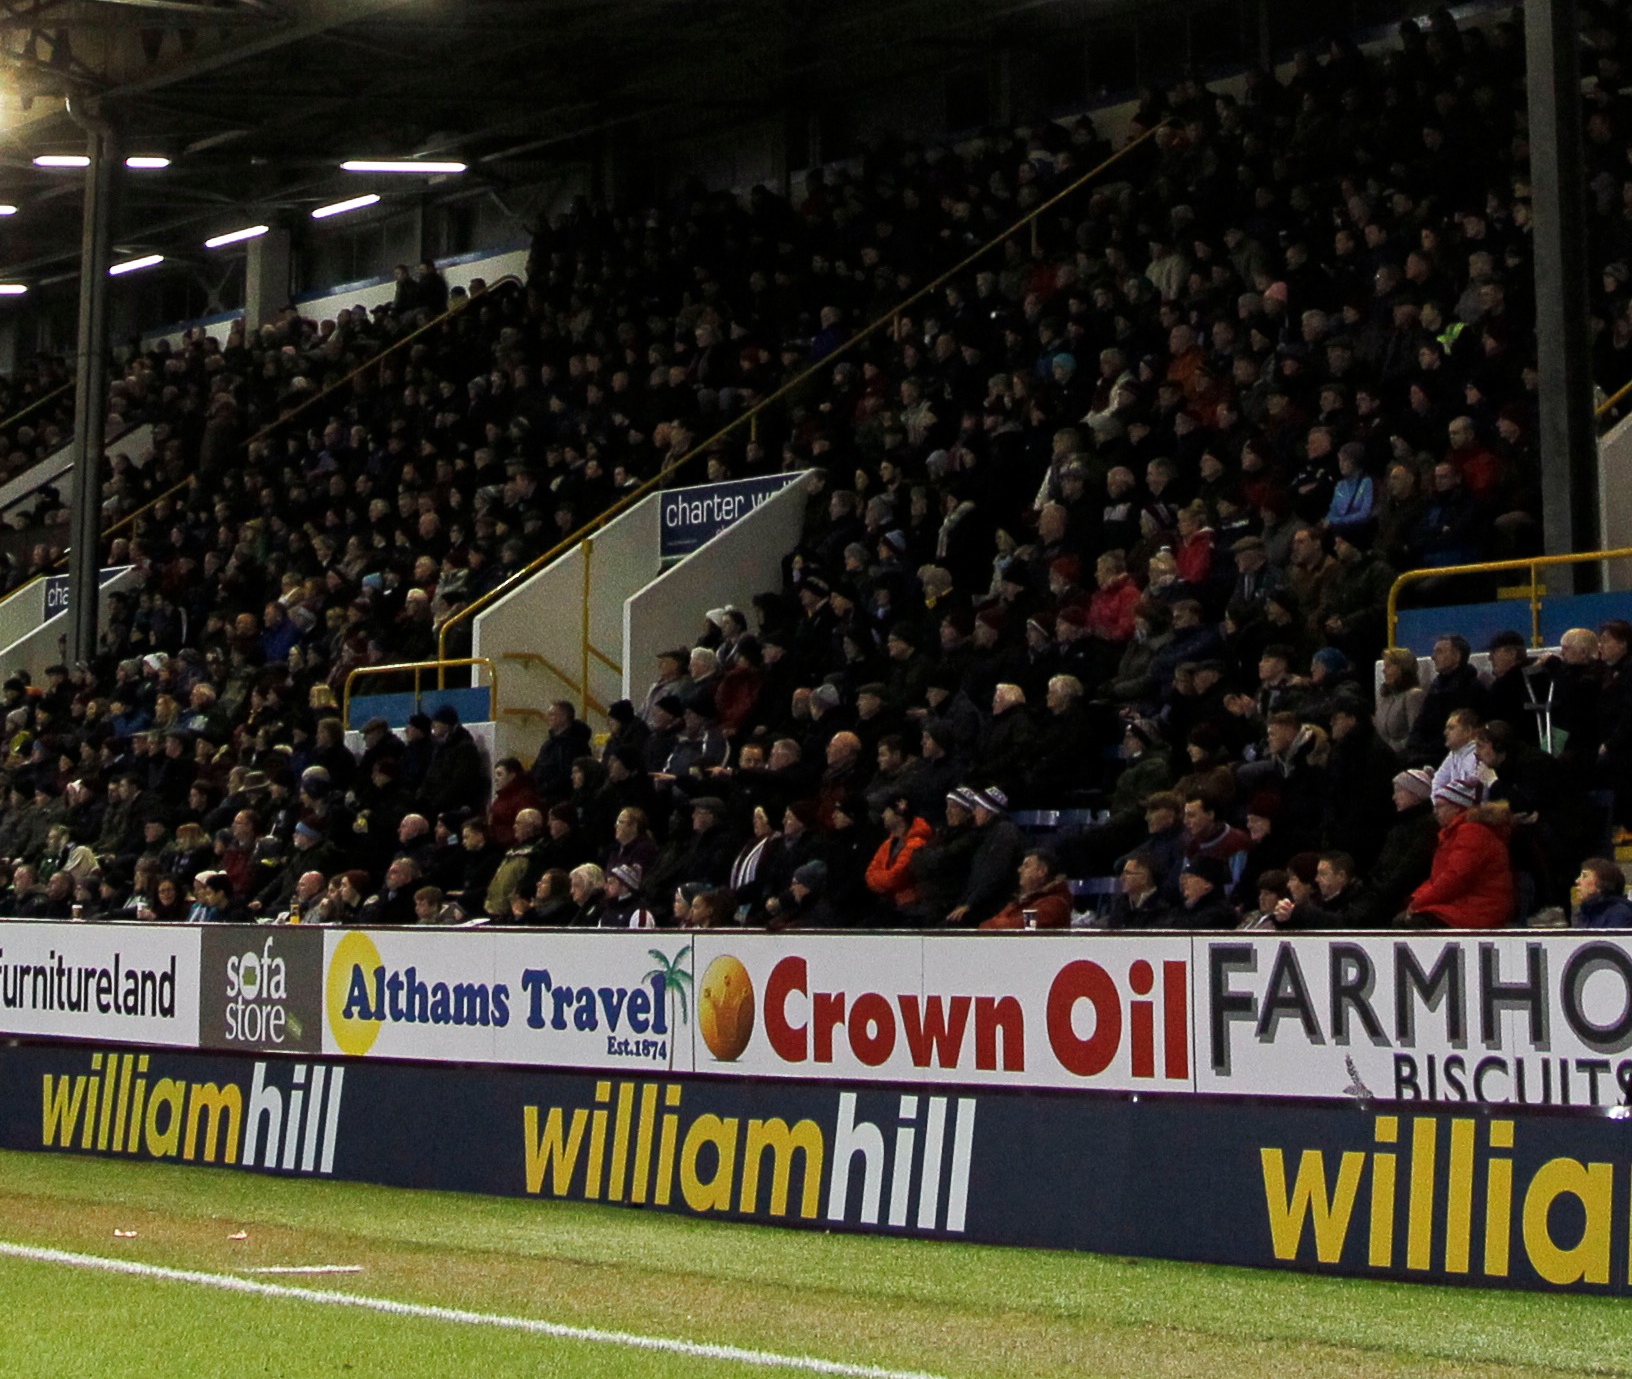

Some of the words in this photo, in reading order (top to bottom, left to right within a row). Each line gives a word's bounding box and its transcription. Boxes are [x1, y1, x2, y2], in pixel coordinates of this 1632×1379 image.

[666, 493, 745, 527] charter
[226, 936, 287, 1000] sofa
[225, 994, 286, 1043] store
[344, 961, 509, 1029] Althams
[521, 966, 668, 1036] Travel
[765, 956, 1027, 1072] Crown
[1047, 959, 1188, 1080] Oil
[606, 1035, 668, 1060] Est.1874
